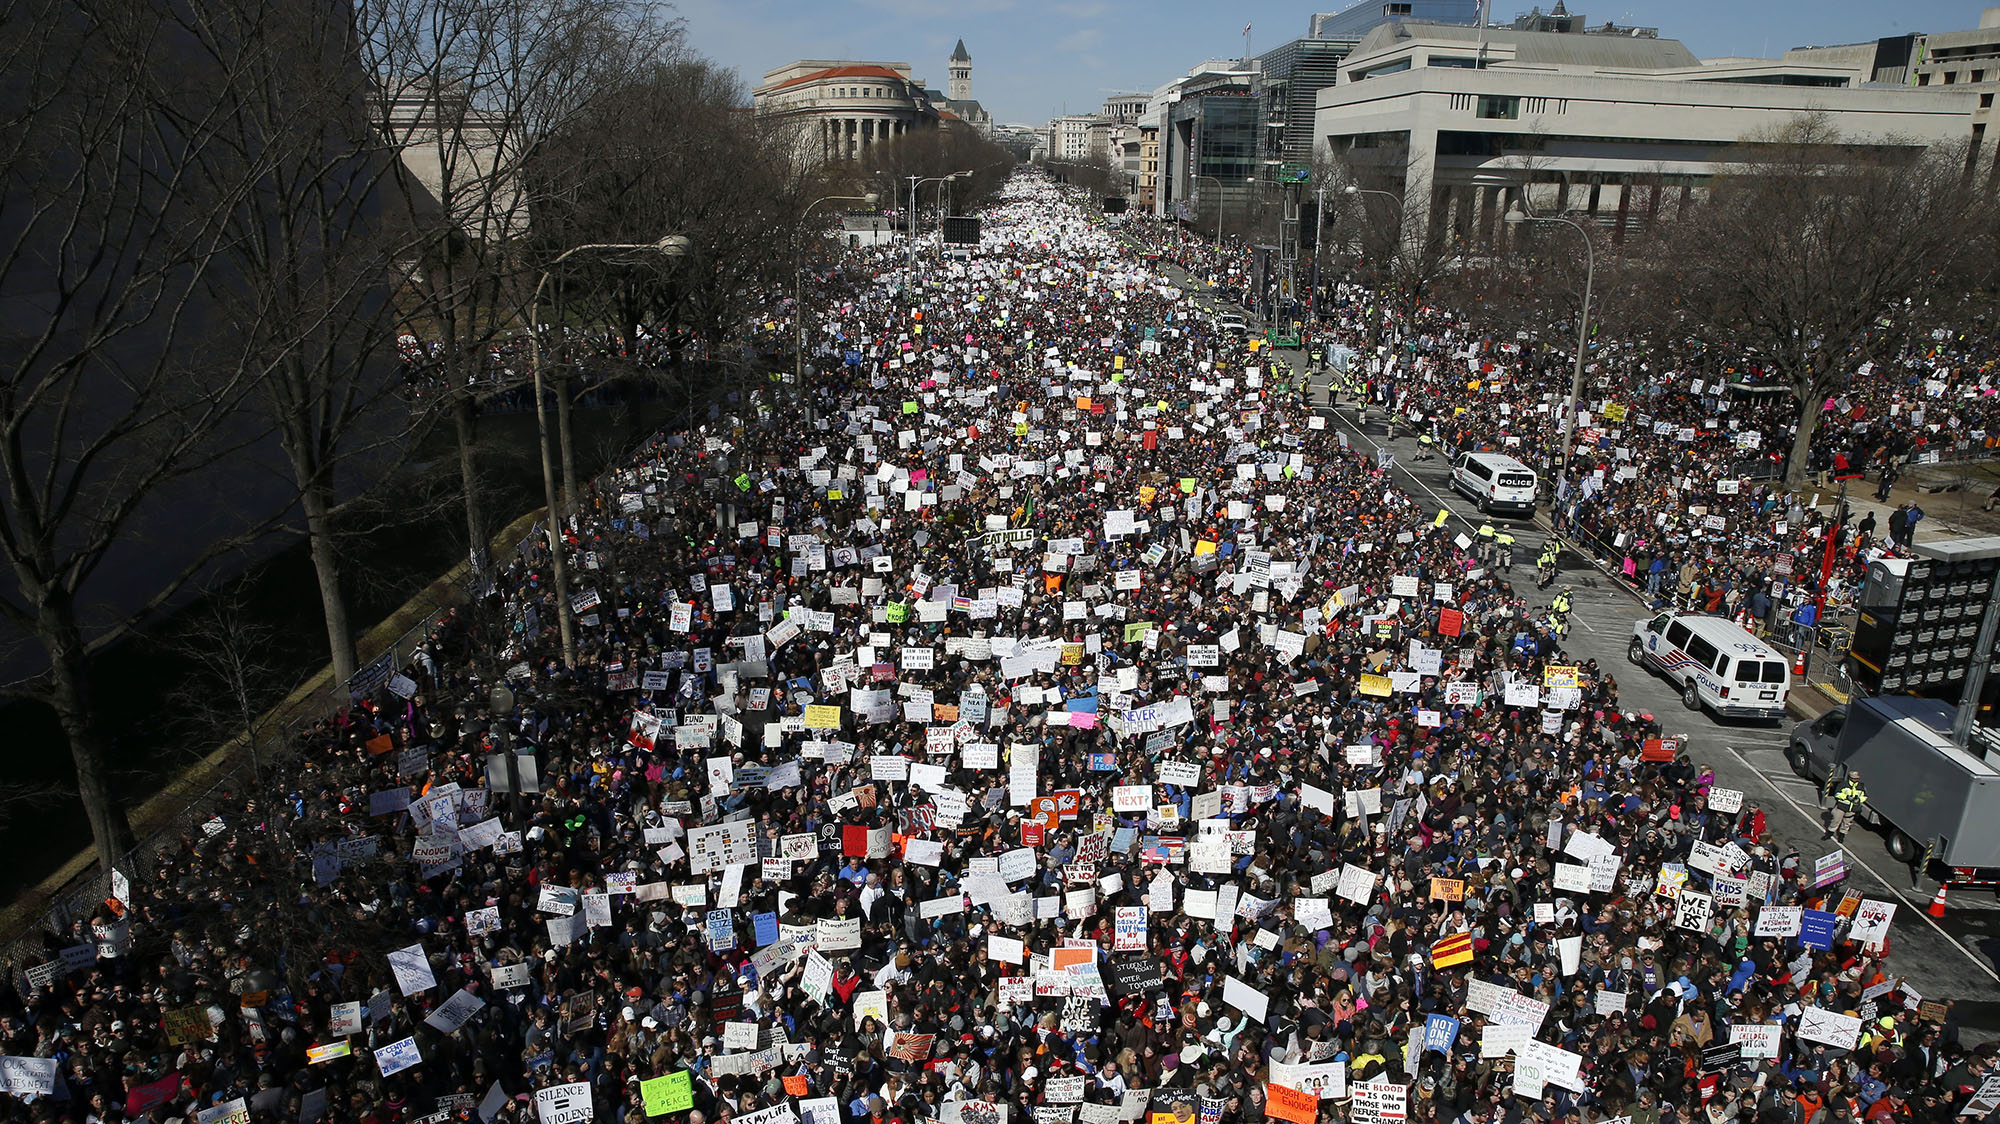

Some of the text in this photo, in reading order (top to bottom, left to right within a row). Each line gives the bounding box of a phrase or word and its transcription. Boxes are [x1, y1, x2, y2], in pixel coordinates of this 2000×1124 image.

[1499, 478, 1533, 487] POLICE
[1005, 529, 1033, 543] MILLS
[1696, 672, 1720, 694] POLICE
[1122, 708, 1156, 722] NEVER
[1123, 720, 1158, 733] AGAIN
[928, 743, 953, 753] NEXT
[964, 744, 978, 752] ONE
[468, 792, 483, 800] AM
[1116, 787, 1131, 796] AM
[433, 799, 449, 810] AM
[1709, 796, 1724, 804] ASK
[1084, 830, 1106, 846] HOW
[415, 846, 449, 857] ENOUGH
[1080, 841, 1105, 855] MANY
[1078, 872, 1095, 880] NOW
[1312, 871, 1338, 883] HISTORY
[1436, 879, 1460, 888] PROTECT
[1716, 877, 1746, 887] PROTECT
[541, 884, 556, 892] NRA
[1441, 886, 1454, 894] KIDS
[1659, 884, 1676, 898] BS
[1715, 882, 1742, 895] KIDS
[1681, 893, 1708, 909] WE
[1715, 895, 1741, 905] GUNS
[709, 910, 729, 921] GEN
[1680, 905, 1707, 918] CALL
[1861, 910, 1888, 923] OVER
[1681, 913, 1702, 931] BS
[1118, 925, 1131, 934] BUY
[791, 933, 815, 944] BOOKS
[1068, 939, 1093, 948] ARMS
[1116, 960, 1148, 973] STUDENT
[1007, 976, 1024, 985] NRA
[1119, 975, 1141, 984] VOTER
[1037, 986, 1054, 996] NOT
[1431, 1018, 1454, 1029] NOT
[731, 1030, 752, 1038] GUN
[1732, 1025, 1765, 1034] PROTECT
[1429, 1029, 1451, 1042] ONE
[1738, 1033, 1769, 1041] CHILDREN
[385, 1038, 414, 1055] CENTURY
[1427, 1039, 1448, 1051] MORE
[1752, 1040, 1769, 1048] GUNS
[1828, 1034, 1852, 1049] AFRAID
[764, 1053, 780, 1064] NOT
[823, 1058, 839, 1067] WITH
[832, 1053, 849, 1063] FUCK
[2, 1058, 27, 1072] OUR
[15, 1070, 53, 1080] GENERATION
[1519, 1064, 1540, 1080] MSD
[29, 1079, 50, 1090] NEXT
[1354, 1082, 1403, 1093] THE BLOOD
[539, 1085, 585, 1103] SILENCE
[1267, 1083, 1300, 1099] ENOUGH
[1367, 1091, 1395, 1101] IS ON
[661, 1094, 689, 1108] PEACE
[1136, 1096, 1147, 1104] NO
[1282, 1096, 1316, 1112] ENOUGH
[1355, 1100, 1400, 1110] THOSE WHO
[959, 1102, 998, 1113] ARMS
[1354, 1108, 1380, 1117] REFUSE
[546, 1106, 594, 1124] VIOLENCE
